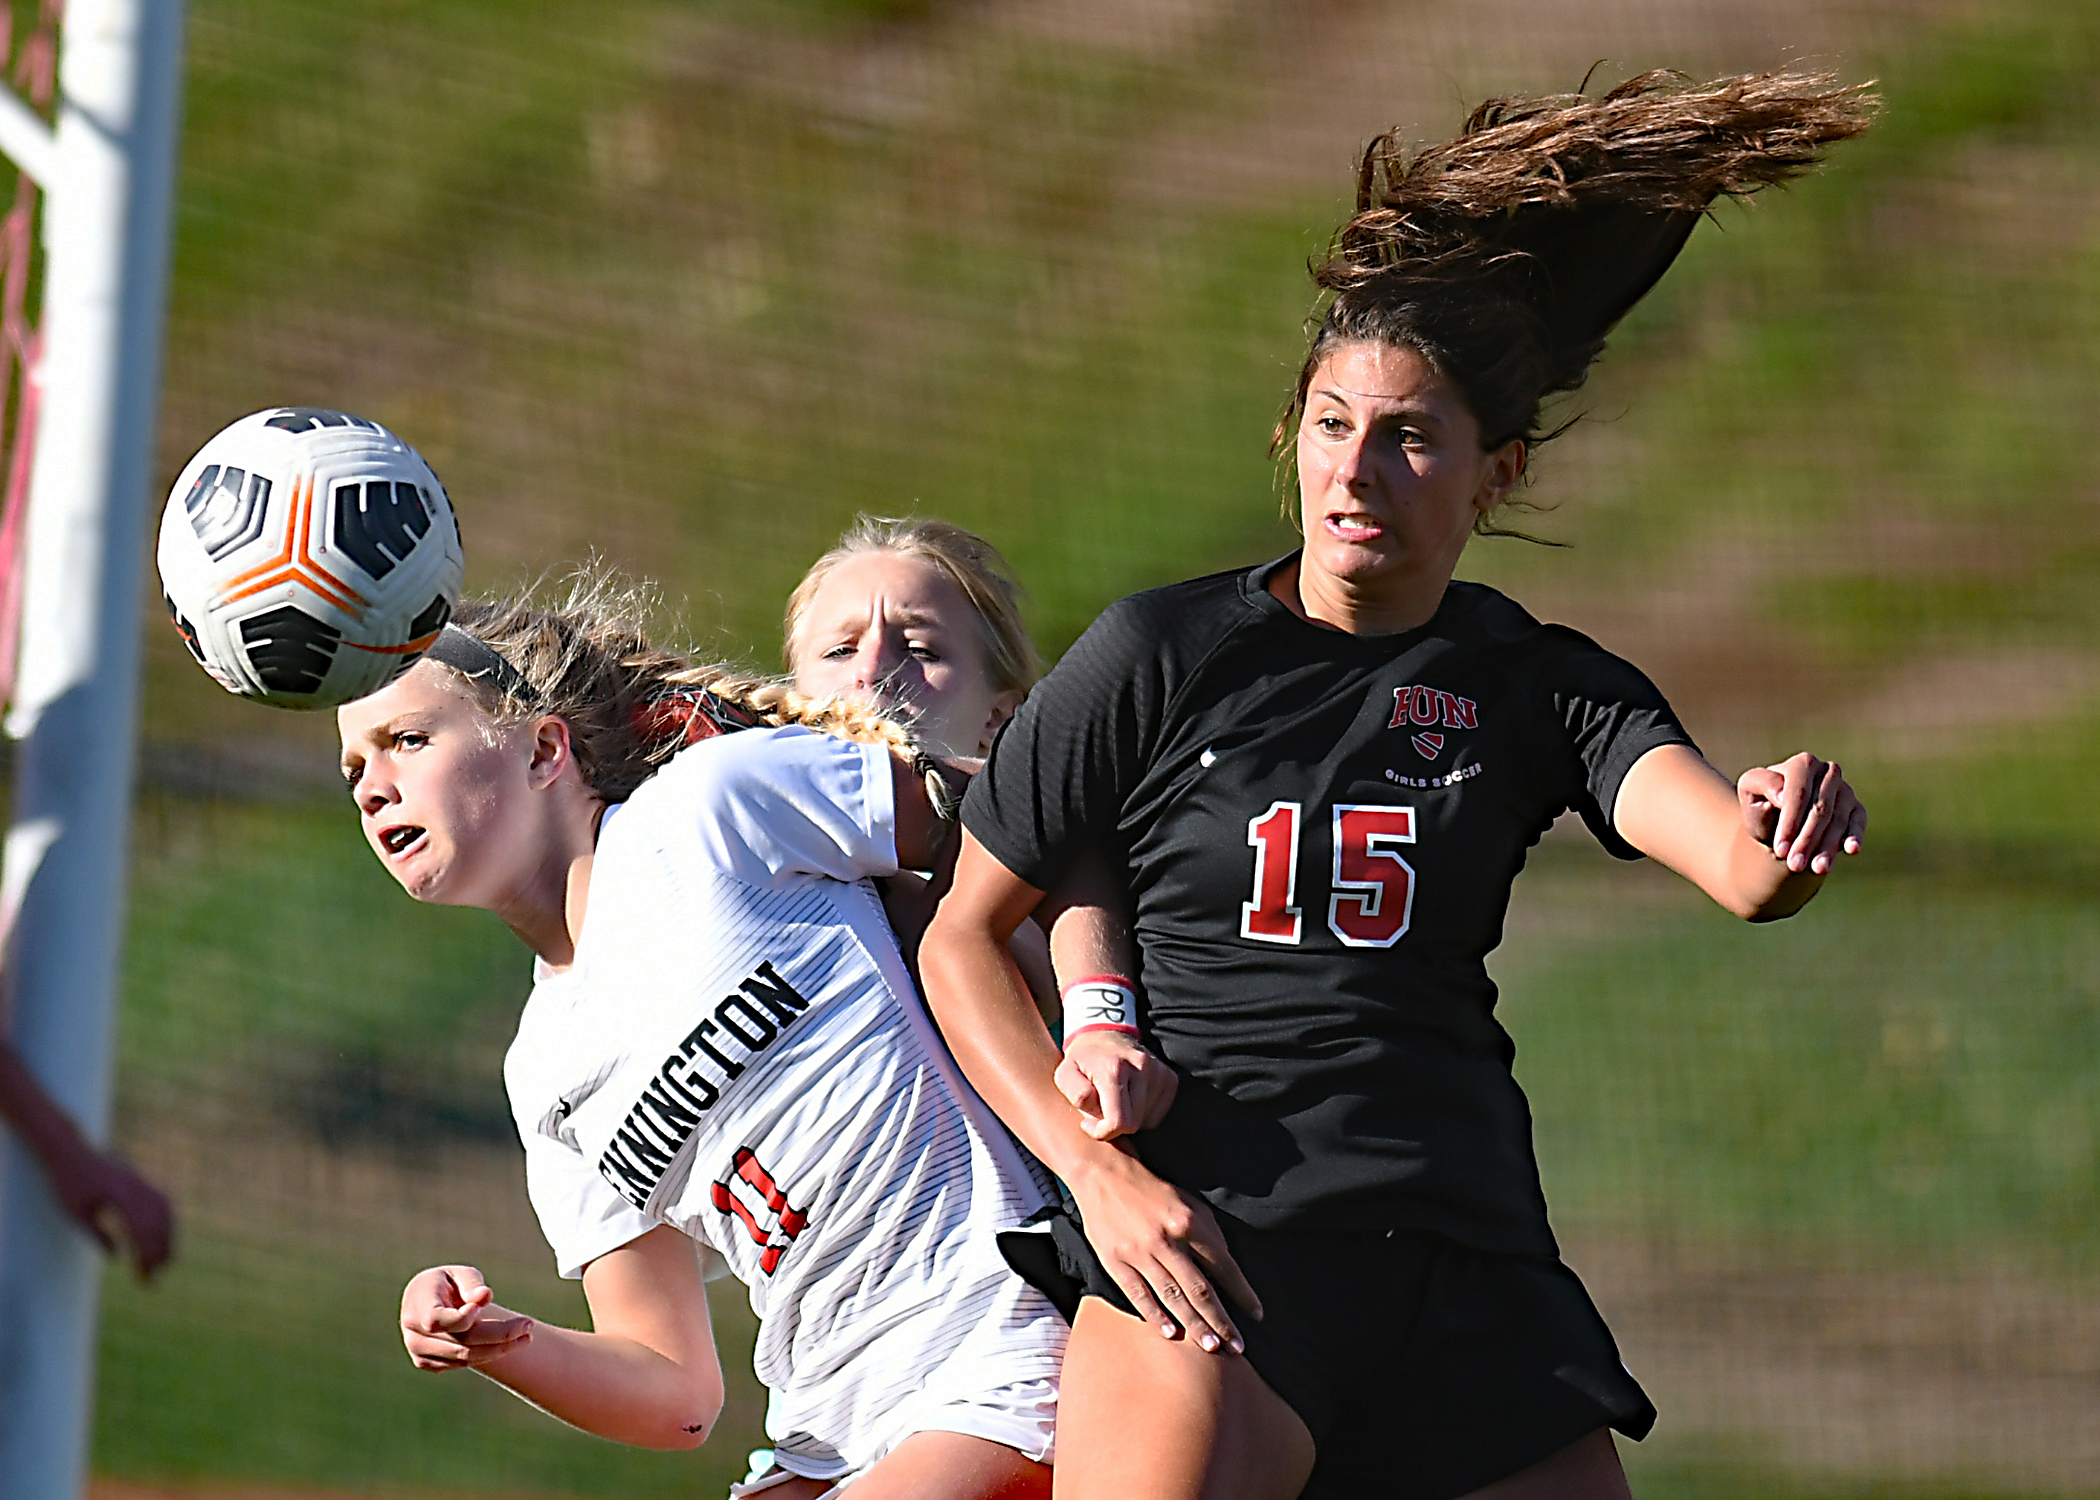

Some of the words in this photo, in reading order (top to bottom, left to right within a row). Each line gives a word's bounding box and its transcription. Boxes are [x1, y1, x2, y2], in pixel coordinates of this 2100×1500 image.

[1385, 768, 1427, 788] GIRLS
[1432, 762, 1482, 788] SOCCER
[1240, 801, 1416, 948] 15
